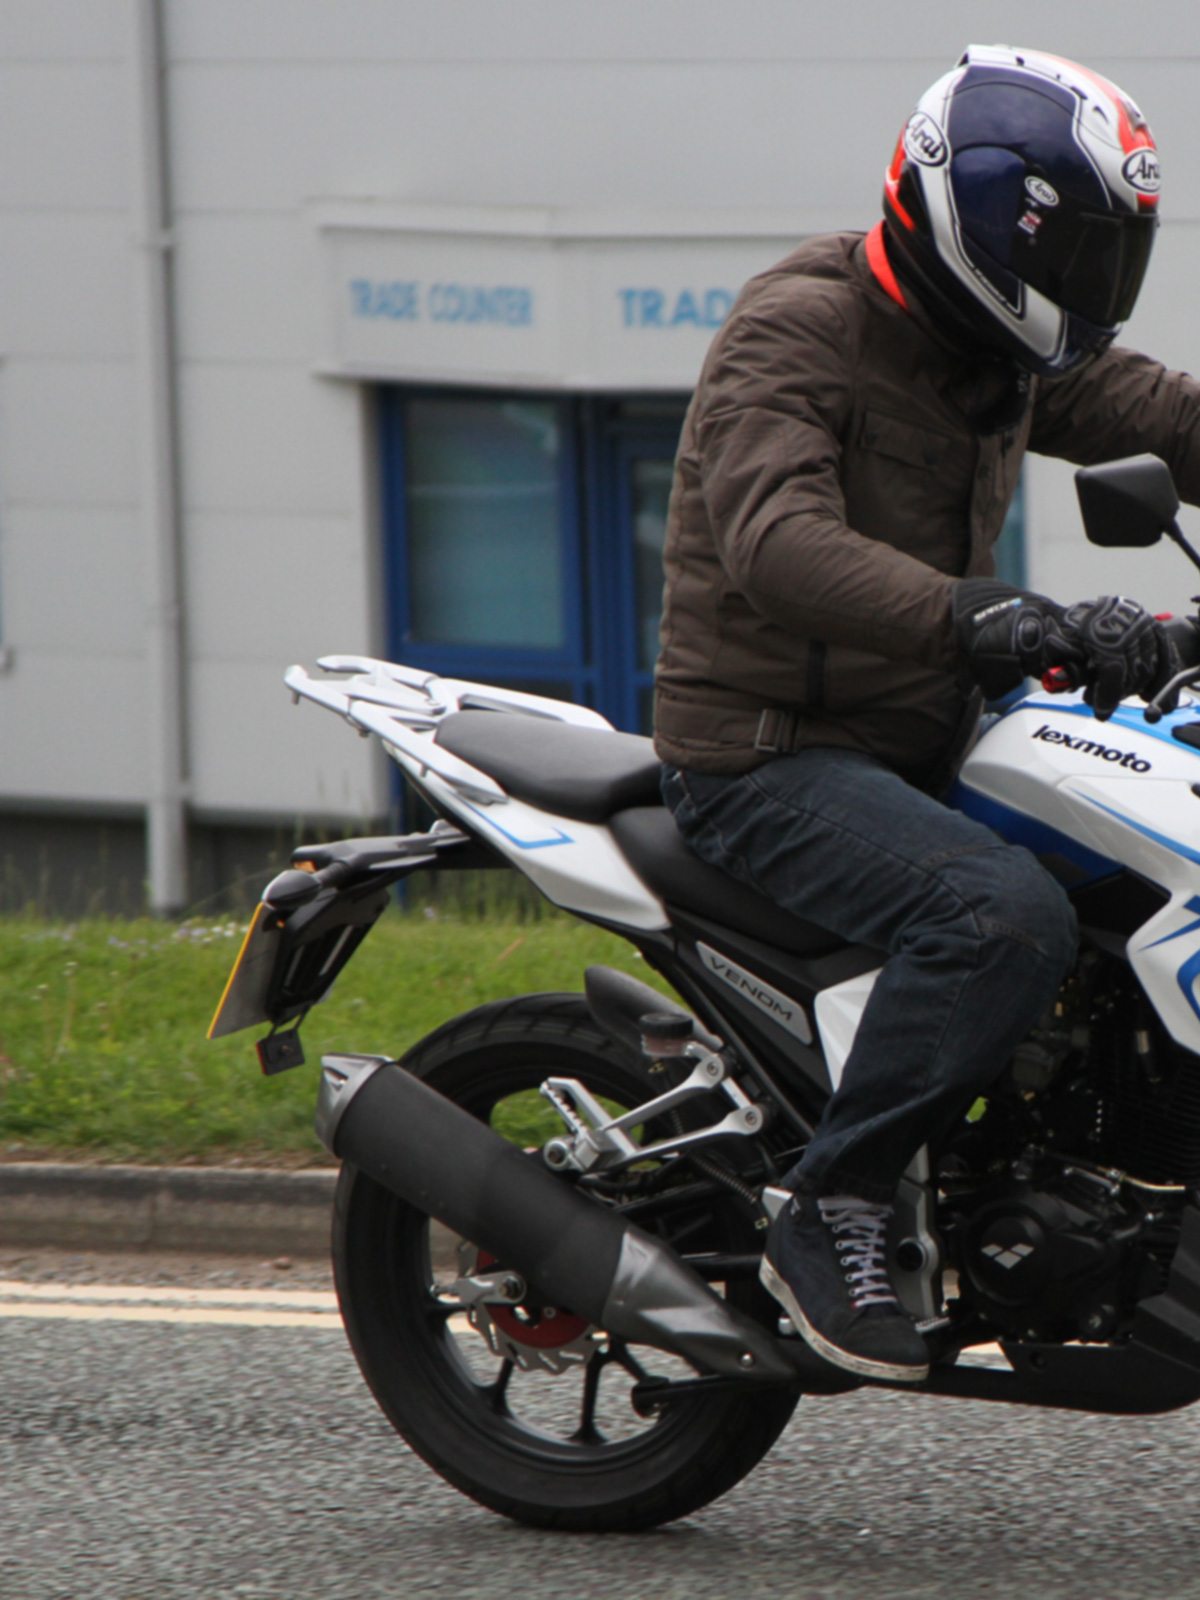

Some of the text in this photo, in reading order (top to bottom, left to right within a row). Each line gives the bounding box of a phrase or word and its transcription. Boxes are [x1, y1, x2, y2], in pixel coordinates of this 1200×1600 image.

[910, 118, 943, 158] Arai
[350, 278, 534, 327] TRADE COUNTER
[617, 287, 738, 329] TRAD
[1031, 725, 1151, 772] lexmoto
[710, 957, 792, 1021] VENOM
